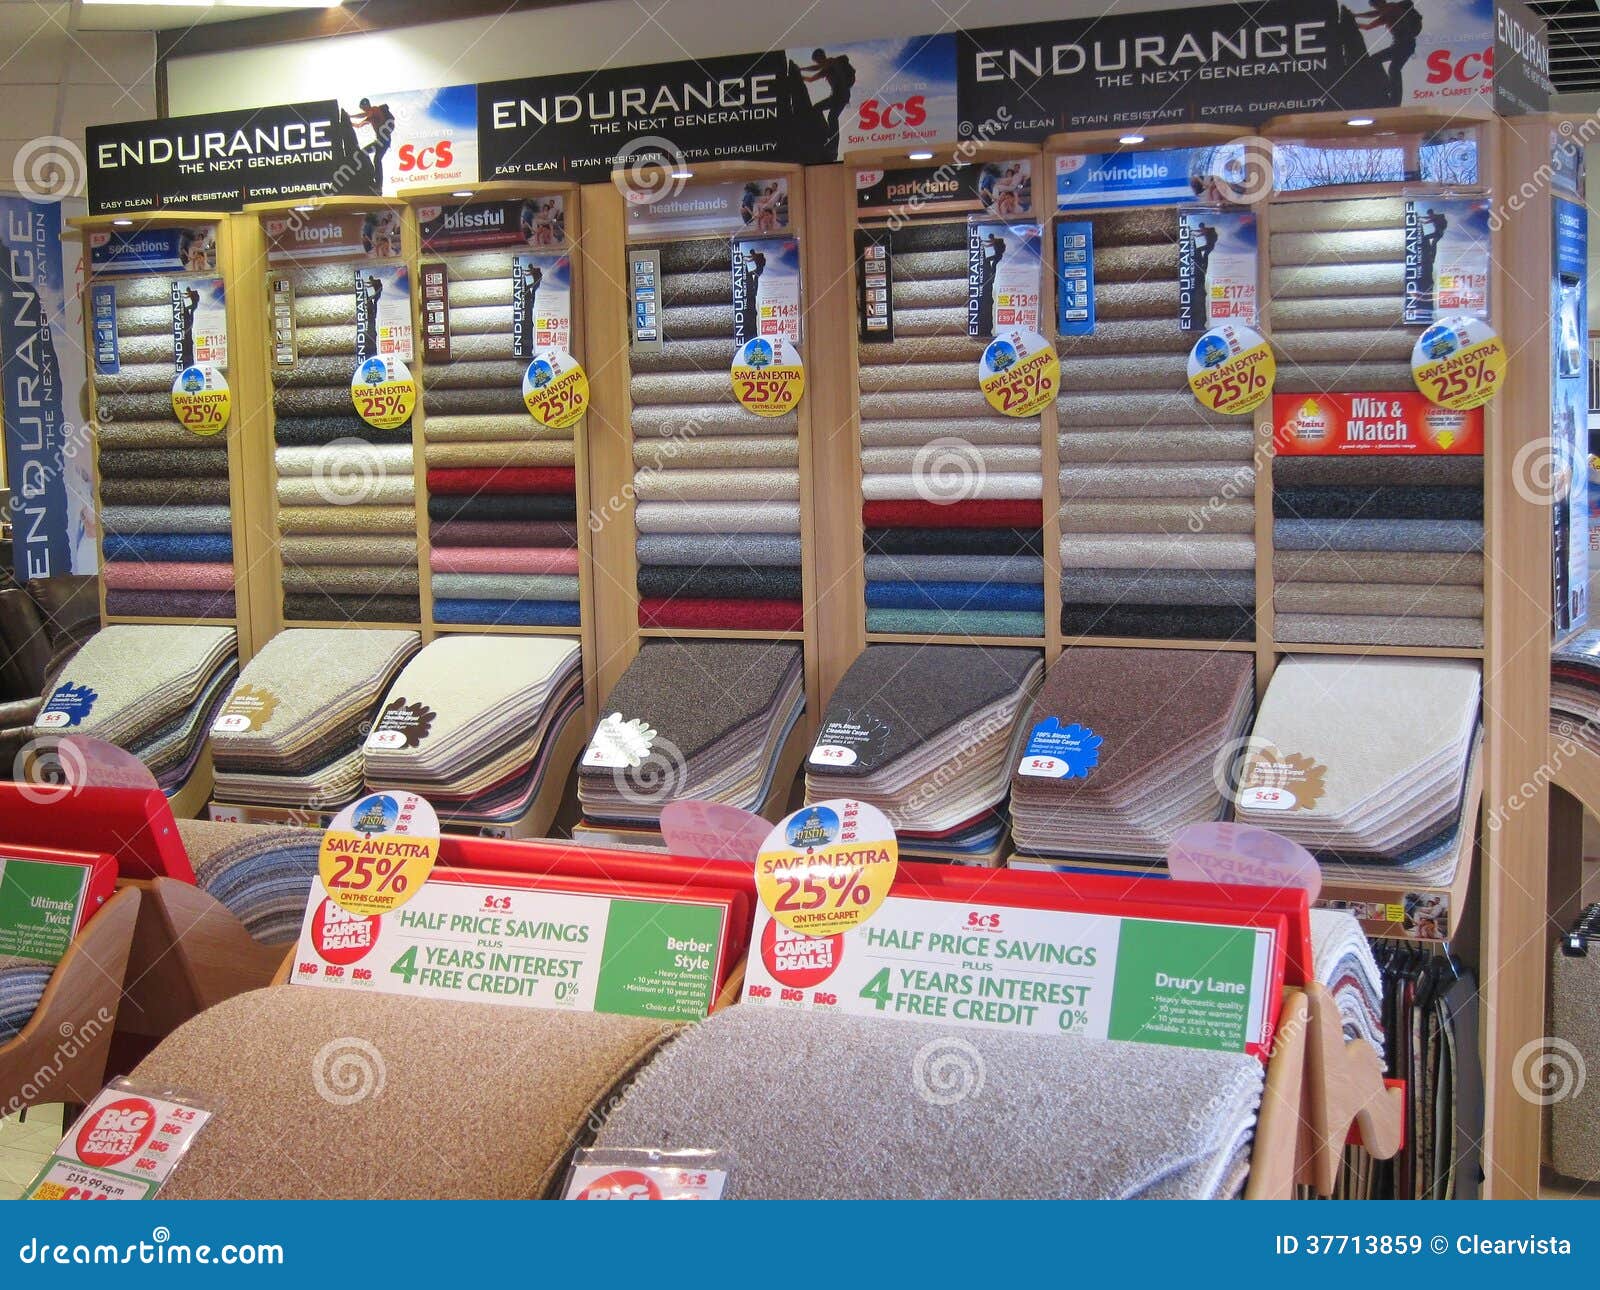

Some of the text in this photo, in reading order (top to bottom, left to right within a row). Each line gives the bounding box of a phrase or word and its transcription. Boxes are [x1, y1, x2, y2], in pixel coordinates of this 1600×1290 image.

[975, 21, 1326, 83] ENDURANCE
[1096, 58, 1327, 88] THE NEXT GENERATION
[493, 74, 777, 130] ENDURANCE
[590, 108, 777, 135] THE NEXT GENERATION
[978, 97, 1327, 133] EASY CLEAN STAIN RESISTANT EXTRA DURABILITY
[98, 120, 333, 170] ENDURANCE
[178, 150, 333, 175] THE NEXT GENERATION
[495, 143, 777, 174] EASY CLEAN STAIN RESISTANT EXTRA DURABILITY
[1087, 163, 1169, 182] invincible
[100, 182, 333, 210] EASY CLEAN STAIN RESISTANT EXTRA DURABILITY
[886, 178, 960, 198] park lane
[649, 197, 728, 214] heatherlands
[444, 207, 505, 230] blissful
[109, 239, 169, 255] sensations
[1180, 215, 1192, 331] ENDURANCE
[1405, 201, 1417, 321] ENDURANCE
[968, 226, 980, 336] ENDURANCE
[513, 256, 523, 356] ENDURANCE
[732, 241, 745, 350] ENDURANCE
[171, 281, 185, 373] ENDURANCE
[354, 270, 367, 365] ENDURANCE
[984, 352, 1052, 394] SAVE AN EXTRA
[1418, 343, 1500, 382] SAVE AN EXTRA
[42, 349, 53, 401] NEXT
[734, 370, 801, 381] SAVE AN EXTRA
[1431, 359, 1497, 403] 25%
[9, 209, 51, 580] ENDURANCE
[742, 381, 792, 403] 25%
[996, 369, 1052, 411] 25%
[1206, 367, 1267, 409] 25%
[182, 403, 222, 424] 25%
[361, 396, 406, 418] 25%
[538, 388, 583, 424] 25%
[1351, 398, 1387, 418] Mix
[1391, 401, 1403, 418] &
[43, 409, 57, 449] THE
[1346, 420, 1408, 441] Match
[326, 837, 430, 859] SAVE AN EXTRA
[763, 848, 890, 874] SAVE AN EXTRA
[327, 855, 408, 894] 25%
[340, 893, 395, 905] ON THIS CARPET
[774, 867, 871, 912] 25%
[30, 896, 74, 911] Ultimate
[45, 911, 71, 925] Twist
[322, 920, 373, 936] CARPET
[399, 909, 589, 943] HALF PRICE SAVINGS
[792, 910, 860, 924] ON THIS CARPET
[322, 934, 371, 951] DEALS!
[476, 938, 503, 949] PLUS
[667, 936, 713, 953] Berber
[774, 939, 834, 956] CARPET
[867, 927, 1097, 967] HALF PRICE SAVINGS
[390, 945, 583, 985] 4 YEARS INTEREST
[674, 954, 710, 972] Style
[775, 954, 833, 972] DEALS!
[961, 960, 993, 972] PLUS
[419, 967, 580, 1001] FREE CREDIT 0%
[638, 976, 707, 990] 10 year wear warranty
[658, 970, 708, 981] Heavy domestic
[1155, 972, 1246, 995] Drury Lane
[859, 966, 1091, 1011] 4 YEARS INTEREST
[676, 998, 705, 1008] warranty
[895, 992, 1089, 1031] FREE CREDIT 0%
[1155, 995, 1244, 1012] Heavy domestic quality
[1159, 1005, 1243, 1021] 10 year wear warranty
[1158, 1014, 1242, 1031] 10 year stain warranty
[82, 1139, 134, 1156] DEALS!
[88, 1128, 142, 1144] CARPET
[65, 1172, 103, 1188] £19.99
